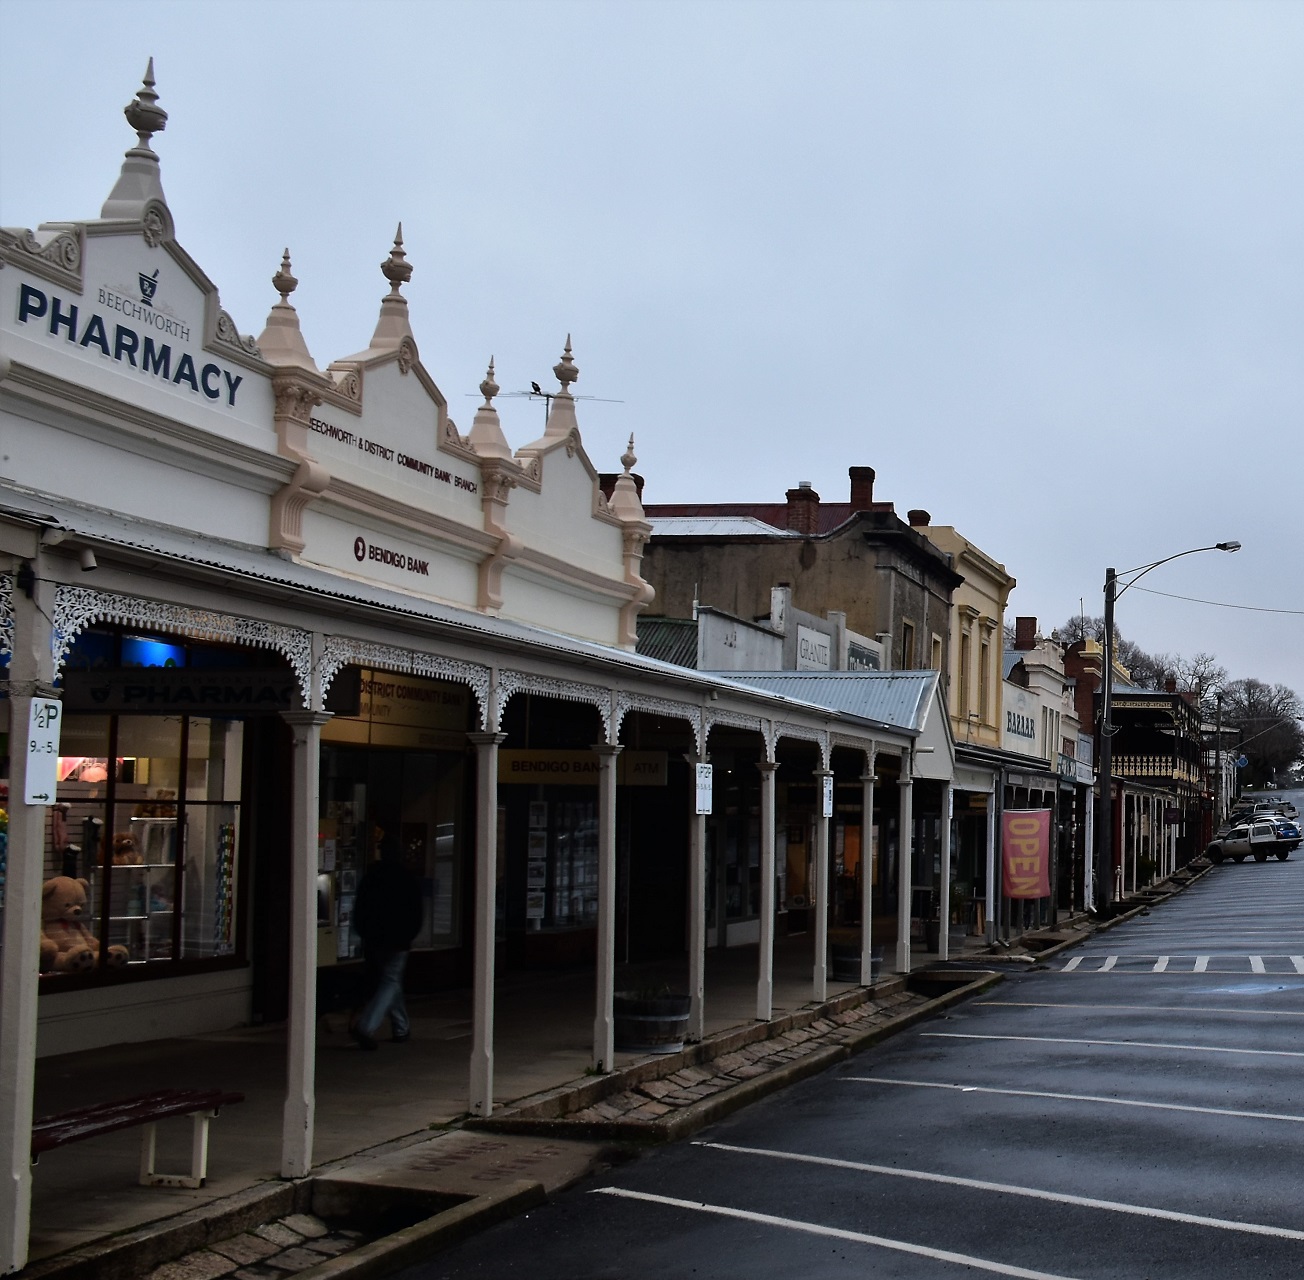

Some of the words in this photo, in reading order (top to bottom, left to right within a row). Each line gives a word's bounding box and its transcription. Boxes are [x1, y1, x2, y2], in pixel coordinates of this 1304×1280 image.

[98, 287, 190, 342] BEECHWORTH
[18, 282, 243, 407] PHARMACY
[358, 437, 364, 450] &
[364, 439, 395, 462] DISTRICT
[397, 453, 434, 477] COMMUNITY
[454, 475, 478, 495] BRANCH
[368, 543, 406, 570] BENDIGO
[407, 556, 430, 577] BANK
[800, 637, 828, 666] GRANITE
[123, 686, 294, 704] PHARMAC
[360, 678, 395, 698] DISTRICT
[396, 684, 441, 704] COMMUNITY
[1007, 710, 1035, 740] BAZAAR
[511, 760, 570, 773] BENDIGO
[573, 761, 600, 773] BAN
[632, 762, 659, 774] ATM
[1009, 818, 1041, 895] OPEN
